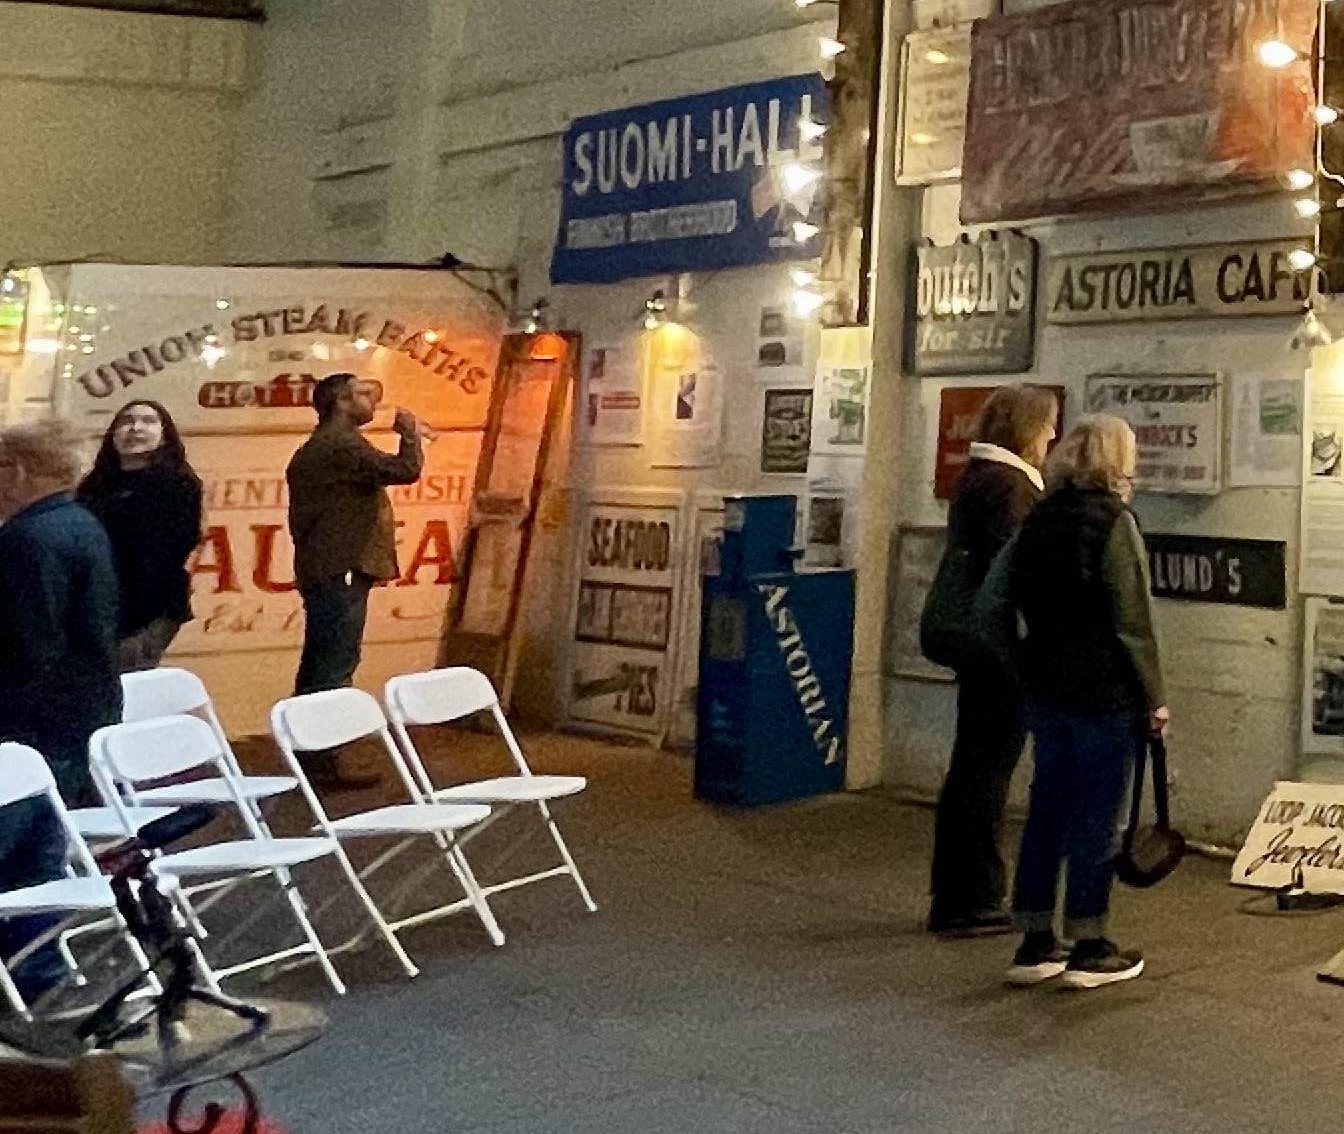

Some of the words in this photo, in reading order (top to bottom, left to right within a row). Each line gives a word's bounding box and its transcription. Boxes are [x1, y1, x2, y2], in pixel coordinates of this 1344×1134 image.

[1053, 257, 1196, 313] ASTORIA
[77, 323, 219, 399] UNION
[231, 302, 367, 343] STEAM
[376, 319, 491, 395] BATHS
[190, 518, 458, 594] AUA
